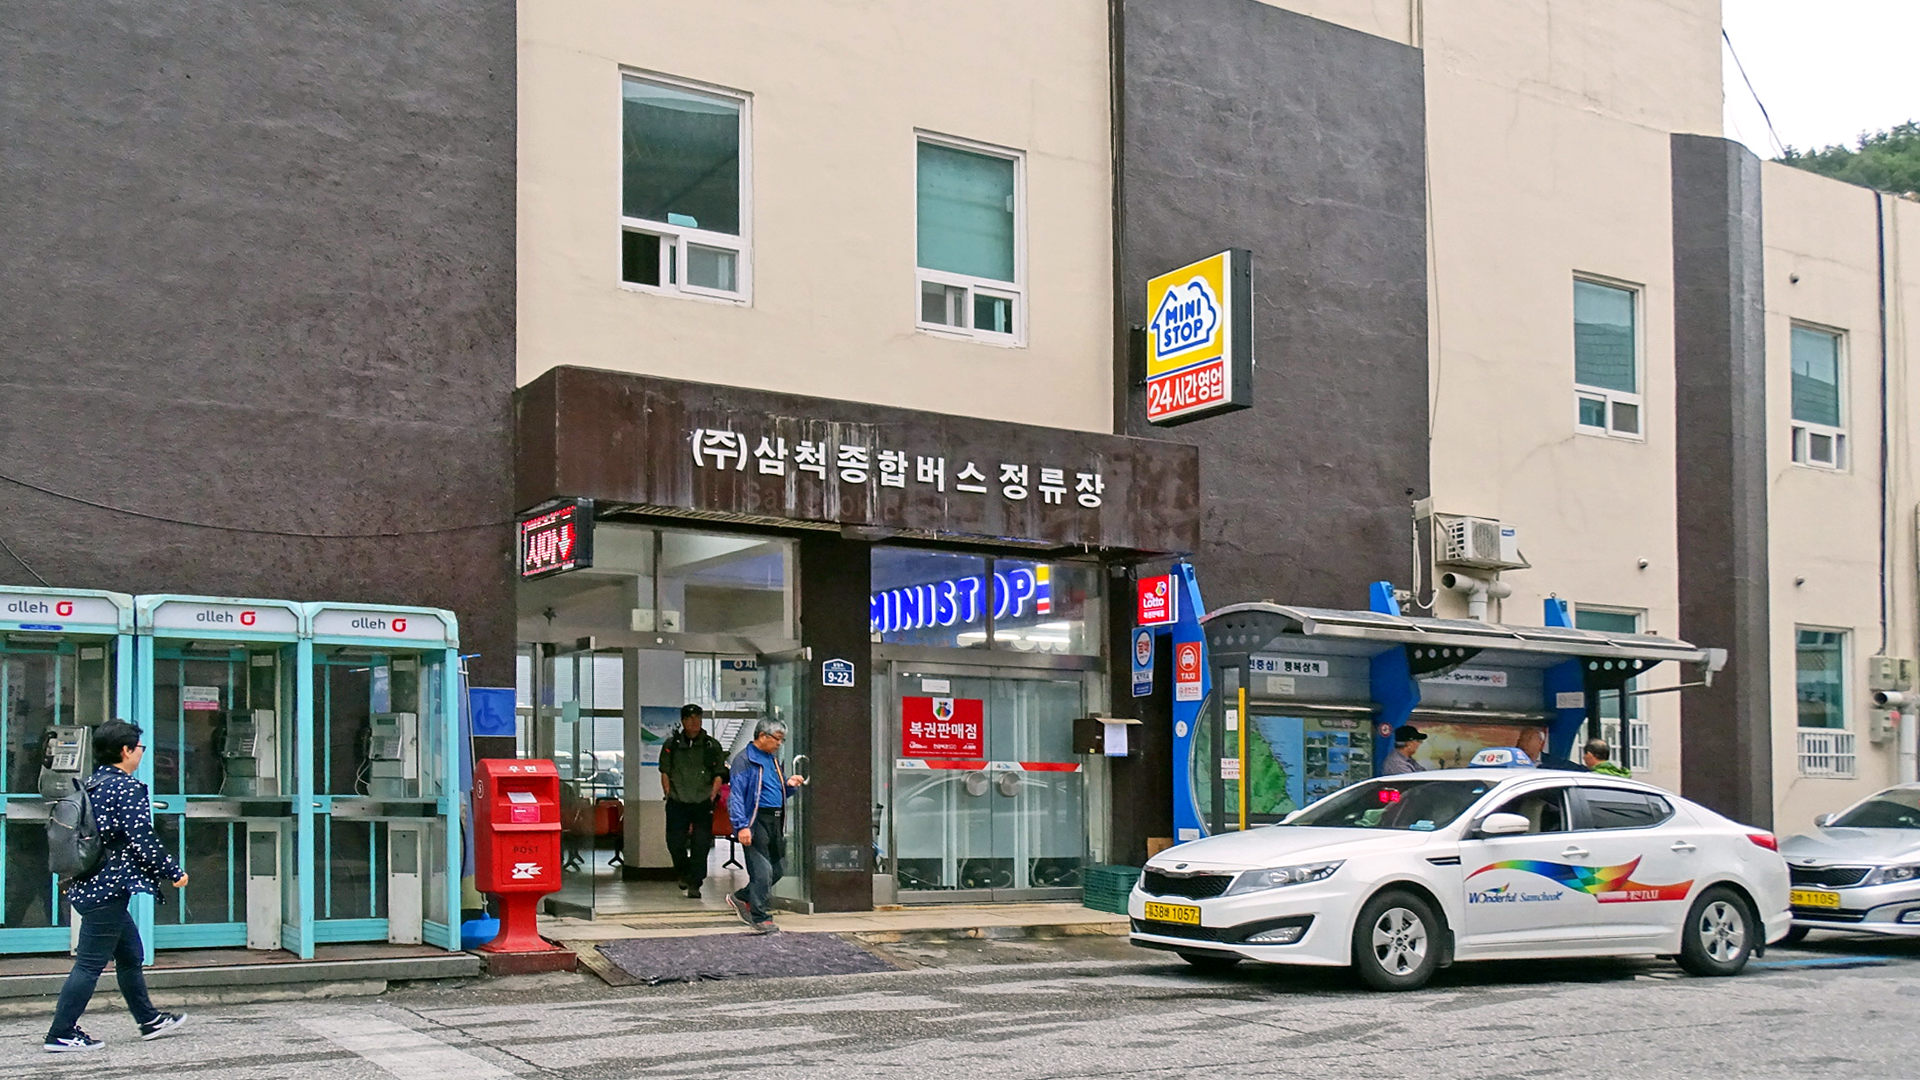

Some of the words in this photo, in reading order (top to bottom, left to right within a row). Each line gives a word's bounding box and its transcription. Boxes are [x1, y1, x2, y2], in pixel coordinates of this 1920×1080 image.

[1165, 298, 1201, 327] MINI
[1164, 318, 1203, 348] STOP
[1150, 366, 1223, 414] 24시간영업
[8, 600, 49, 613] olleh
[870, 568, 1036, 634] MINISTOP
[1143, 597, 1165, 608] Lotto
[196, 610, 234, 623] olleh
[351, 617, 386, 630] olleh
[828, 671, 849, 683] 9-22
[909, 721, 977, 739] 복권판매점
[513, 845, 539, 854] POST
[1806, 893, 1834, 905] 1105
[1172, 907, 1196, 921] 1057
